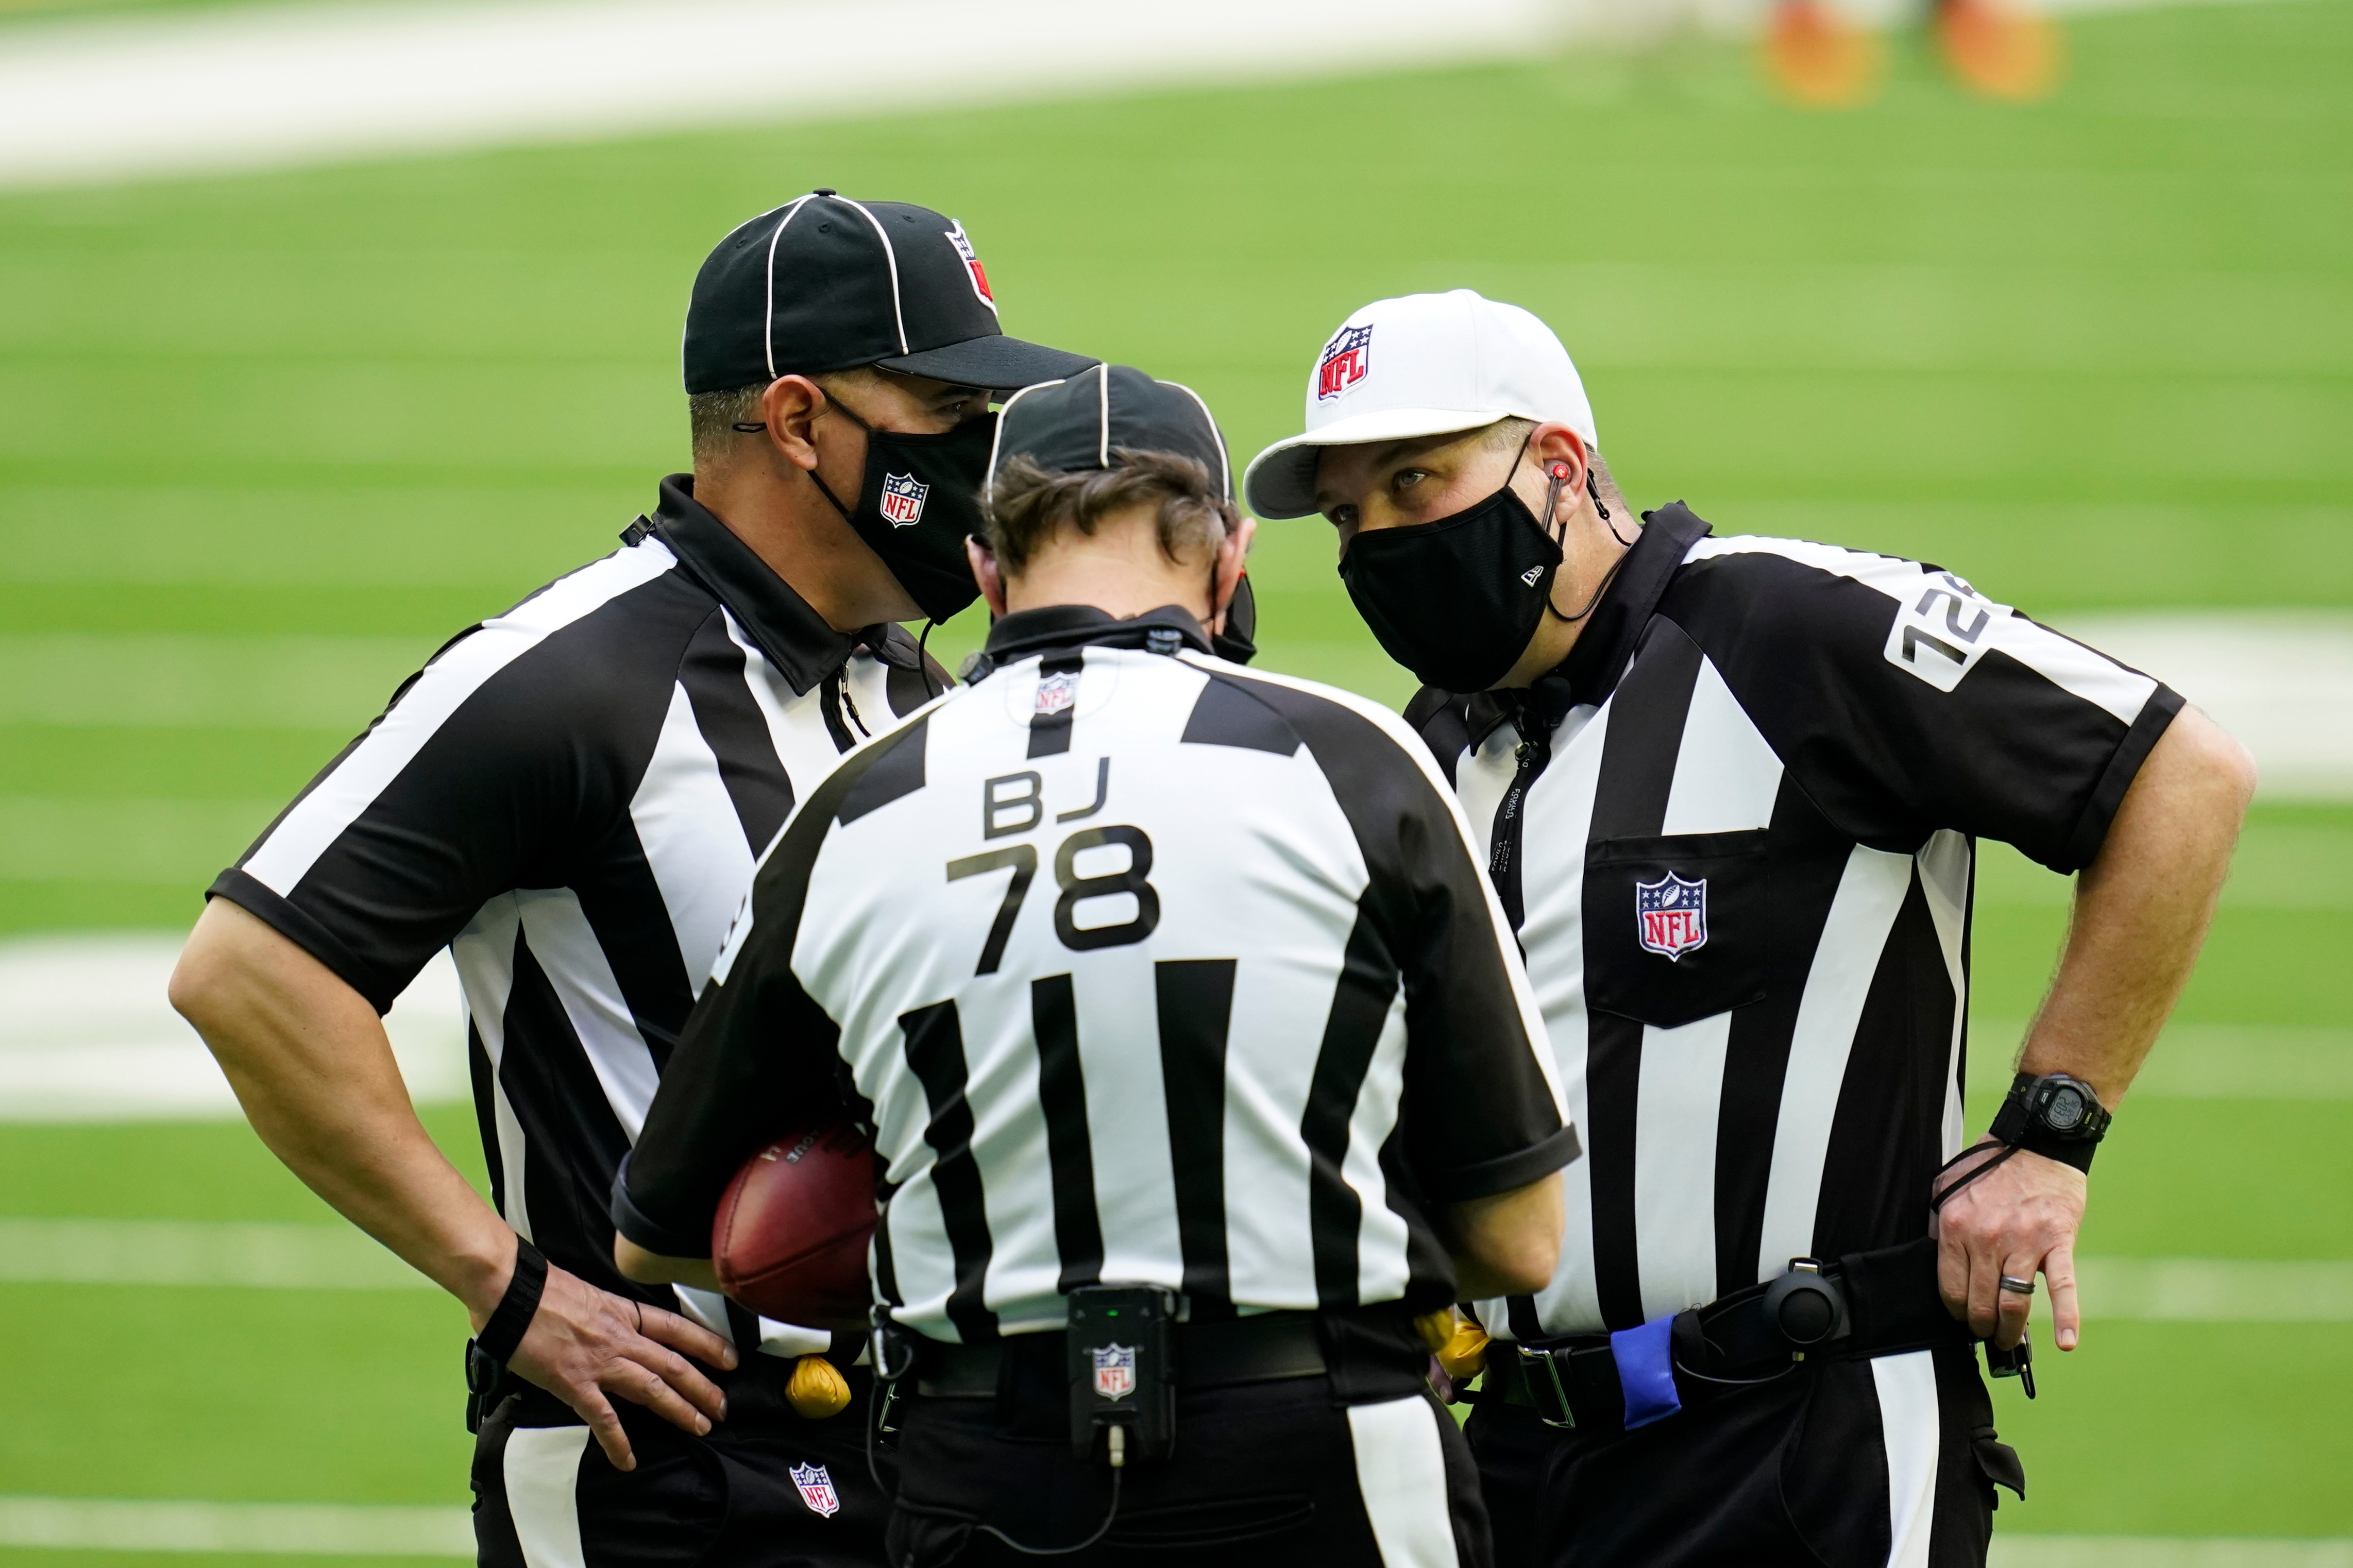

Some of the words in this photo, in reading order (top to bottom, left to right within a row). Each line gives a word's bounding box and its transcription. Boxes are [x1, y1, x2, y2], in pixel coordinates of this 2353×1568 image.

[1319, 349, 1364, 396] NFL
[884, 493, 916, 520] NFL
[1036, 687, 1071, 708] NFL
[984, 756, 1110, 841] BJ
[946, 824, 1161, 978] 78
[1645, 911, 1700, 948] NFL
[1100, 1369, 1131, 1392] NFL
[802, 1486, 835, 1510] NFL
